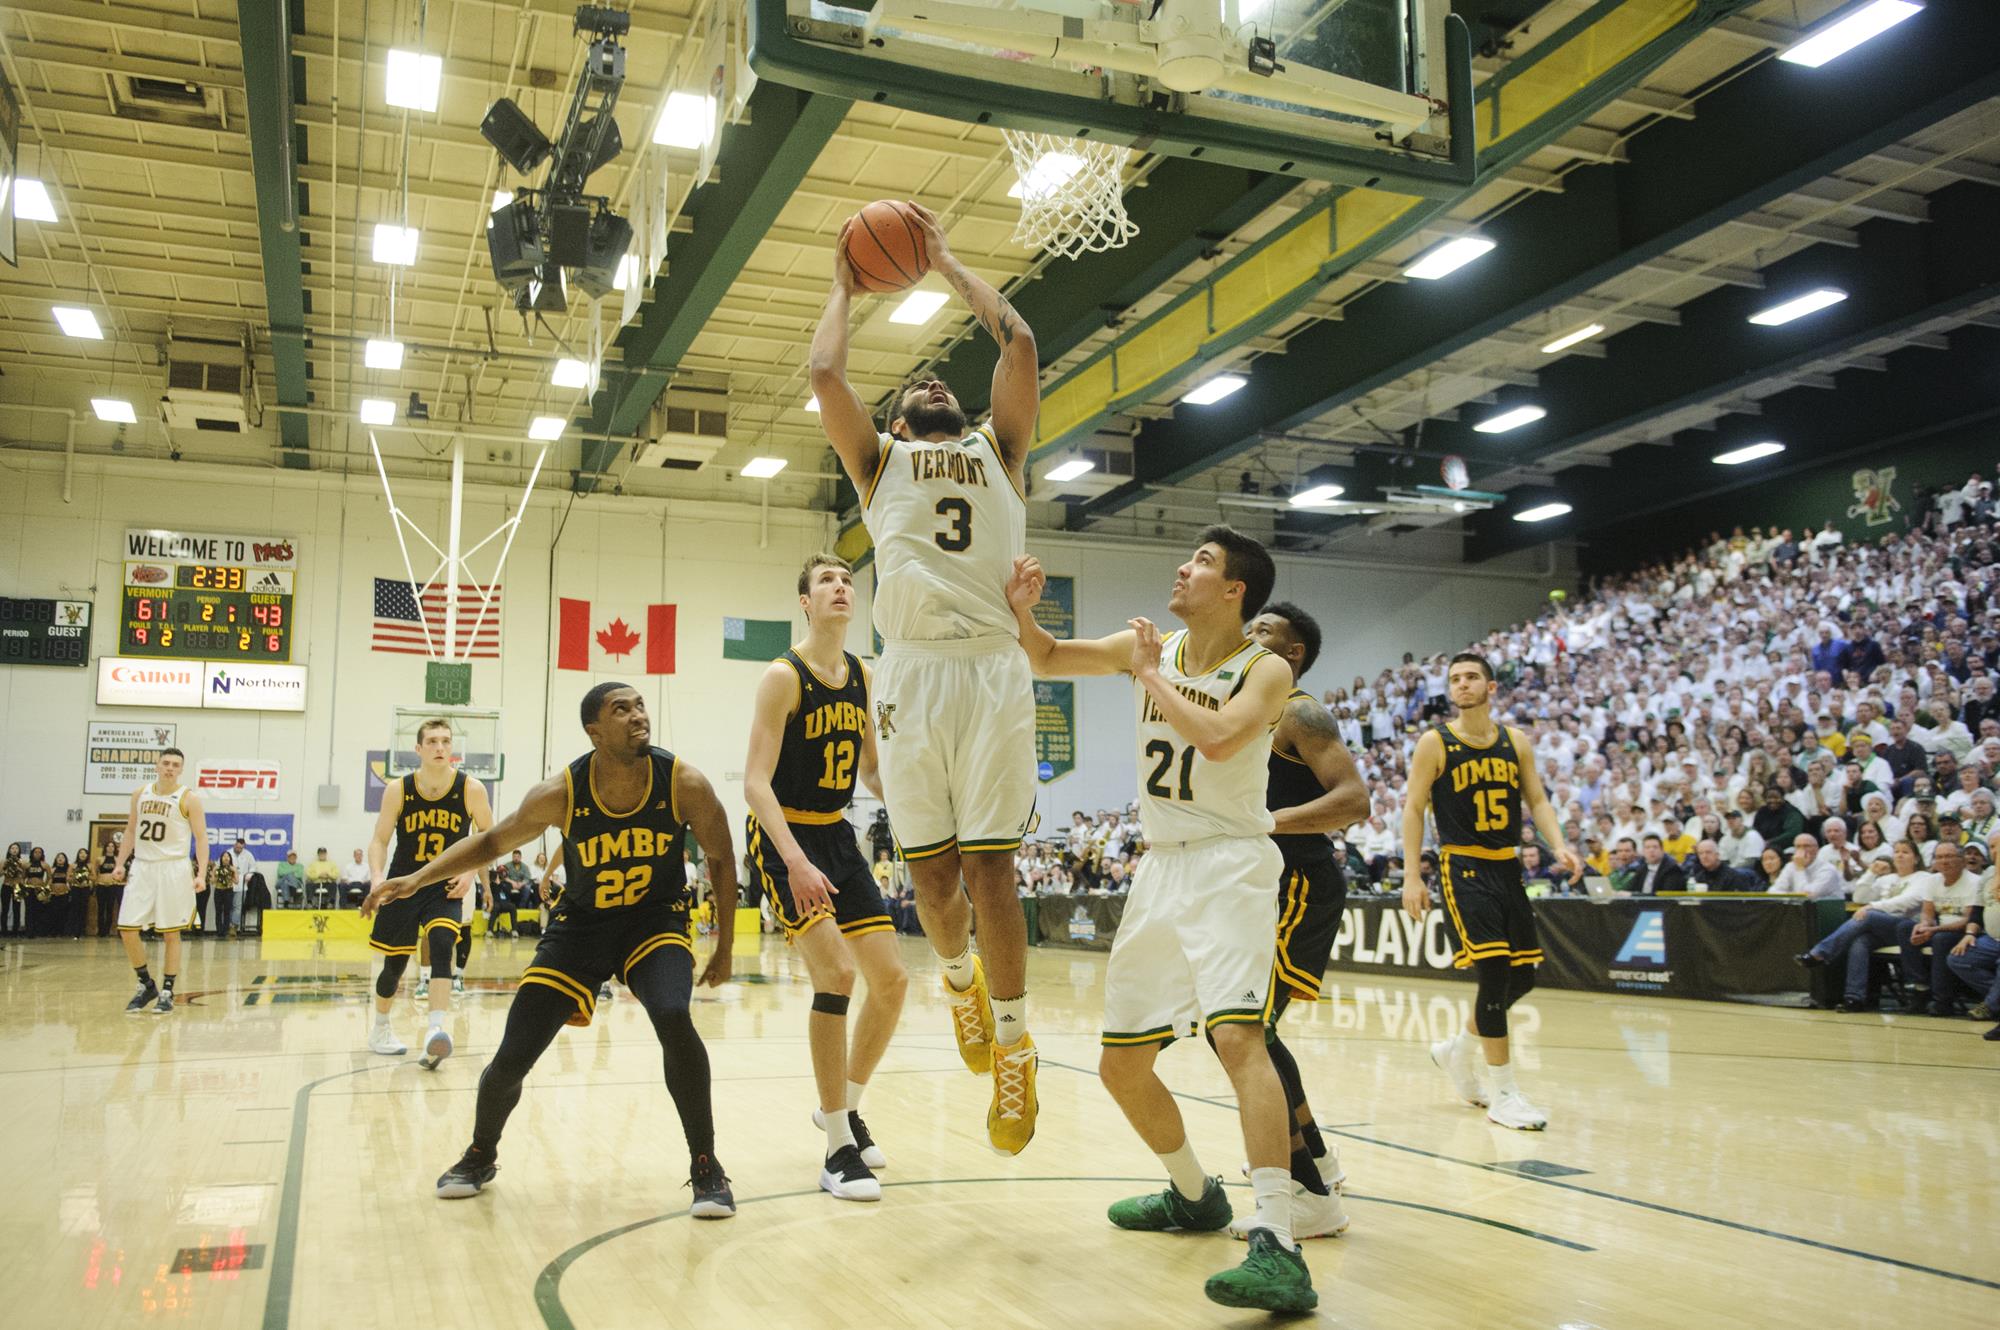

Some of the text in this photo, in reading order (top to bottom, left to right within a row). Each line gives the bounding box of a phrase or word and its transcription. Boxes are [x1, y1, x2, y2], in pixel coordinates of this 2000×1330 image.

[911, 449, 989, 488] VERMONT
[935, 497, 972, 552] 3
[129, 534, 244, 561] WELCOME TO
[193, 566, 241, 589] 2:33
[127, 587, 175, 599] VERMONT
[252, 585, 286, 593] adidas
[196, 596, 221, 604] PERIOD
[250, 593, 282, 605] GUEST
[138, 599, 167, 620] 61
[202, 604, 214, 621] 2
[254, 605, 282, 626] 43
[3, 629, 29, 637] PERIOD
[48, 626, 82, 637] GUEST
[135, 629, 147, 644] 9
[161, 629, 173, 647] 2
[183, 624, 229, 633] PLAYER FOUL
[239, 632, 250, 650] 2
[268, 635, 280, 652] 6
[111, 667, 190, 684] Canon
[235, 678, 300, 689] Northern
[805, 701, 866, 740] UMBC
[92, 749, 161, 764] CHAMPION
[818, 740, 855, 790] 12
[198, 769, 278, 789] ESPN
[1145, 739, 1195, 801] 21
[1451, 757, 1519, 793] UMBC
[140, 800, 172, 818] VERMONT
[1473, 788, 1508, 831] 15
[404, 808, 462, 834] UMBC
[139, 820, 167, 842] 20
[207, 828, 287, 847] GEICO
[415, 833, 445, 862] 13
[576, 827, 673, 868] UMBC
[594, 864, 653, 909] 22
